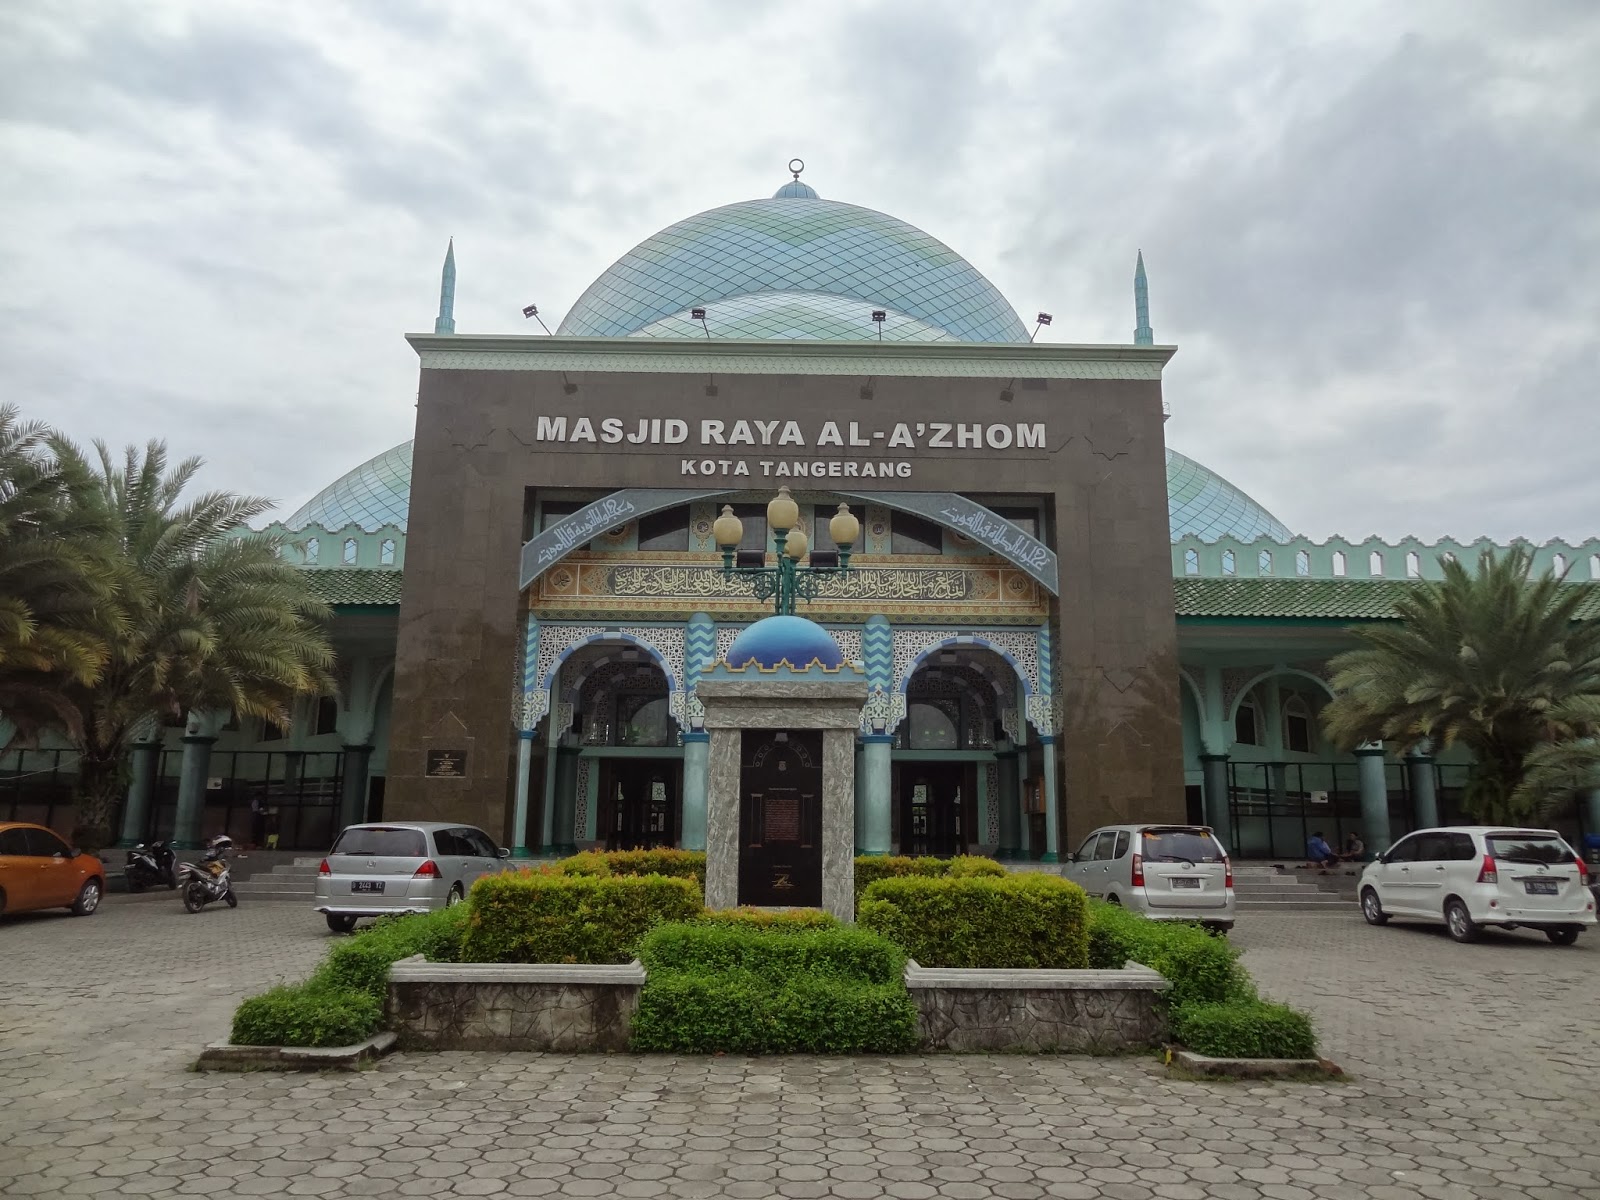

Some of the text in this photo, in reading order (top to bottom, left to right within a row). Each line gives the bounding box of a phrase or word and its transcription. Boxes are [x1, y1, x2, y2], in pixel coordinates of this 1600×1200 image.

[536, 416, 689, 444] MASJID
[700, 420, 806, 446] RAYA
[681, 459, 912, 478] KOTA TANGERANG
